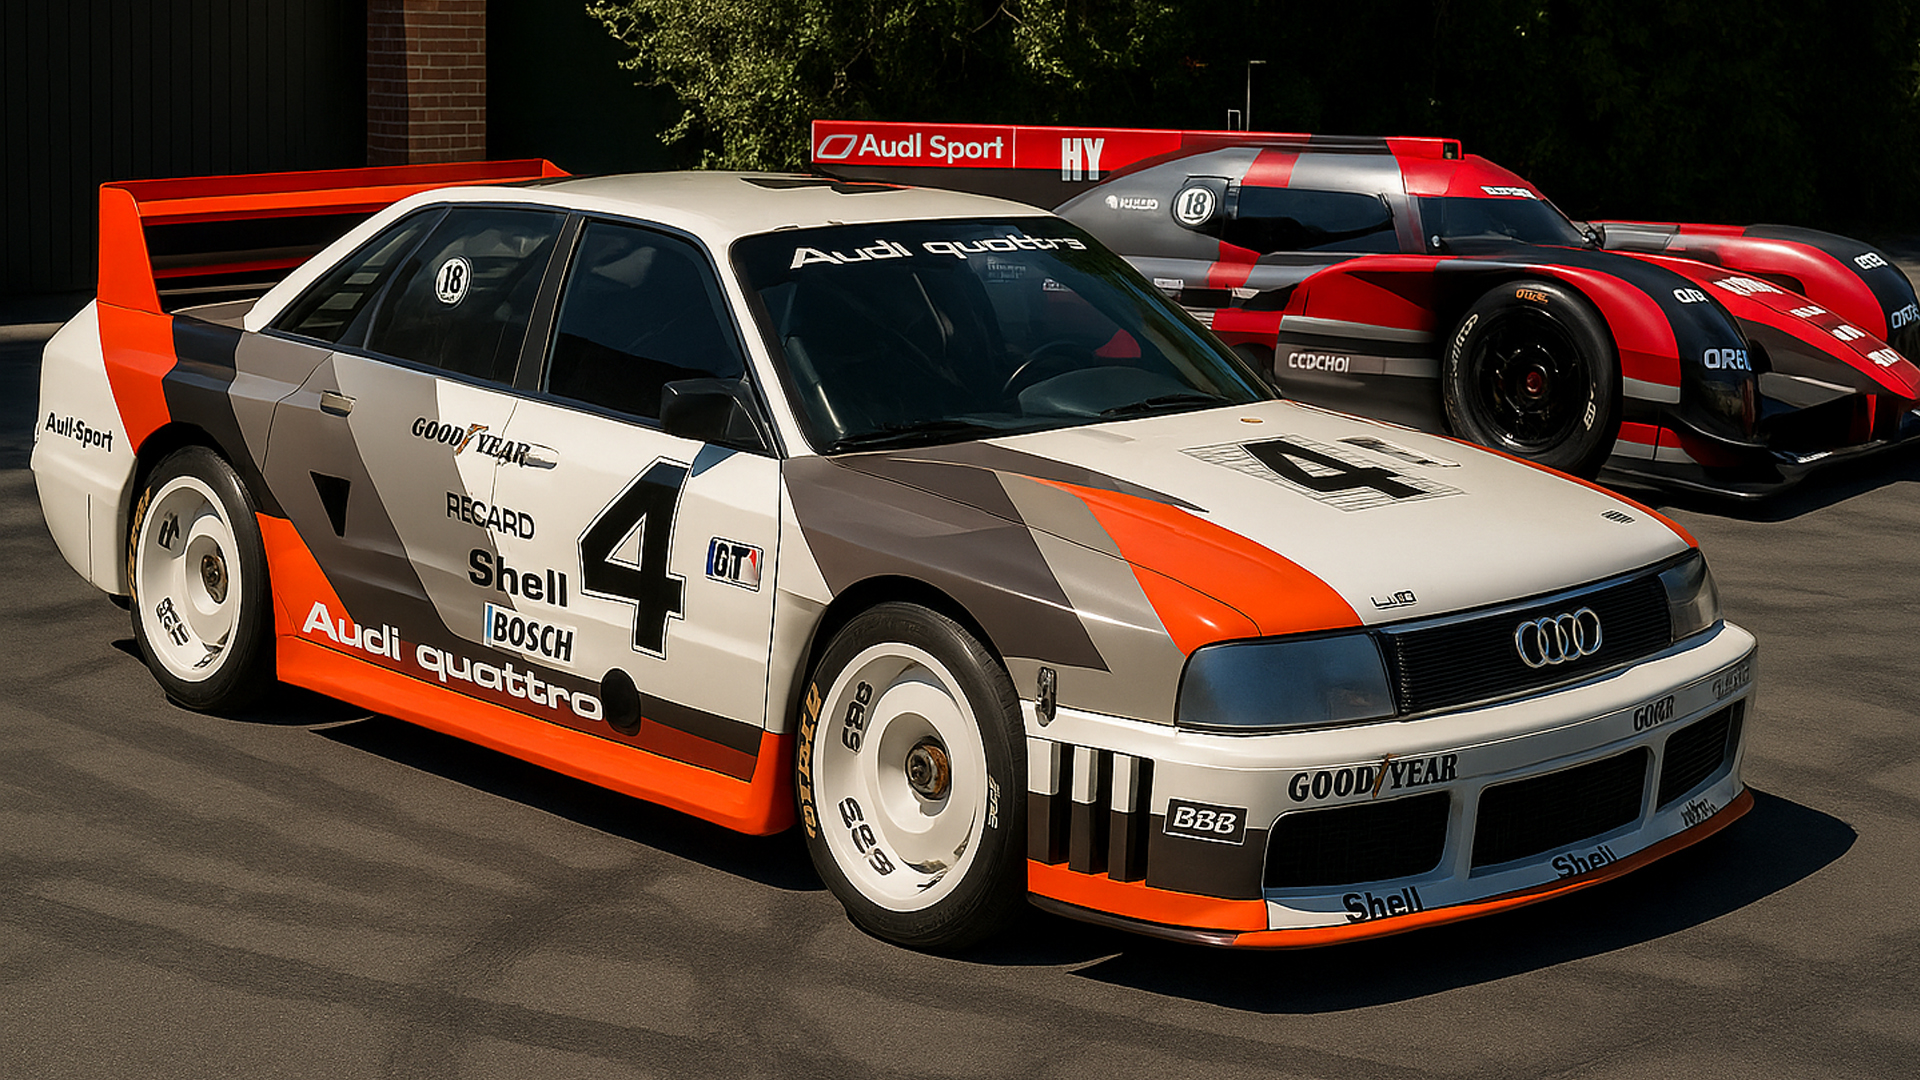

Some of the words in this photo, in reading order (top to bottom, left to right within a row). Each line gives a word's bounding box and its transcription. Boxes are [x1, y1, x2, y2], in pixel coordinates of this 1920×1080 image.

[929, 134, 1004, 164] Sport
[1061, 137, 1105, 182] HY
[1184, 192, 1208, 216] 18
[441, 264, 464, 294] 18
[1239, 438, 1430, 499] 4
[468, 548, 569, 608] Shell
[578, 457, 686, 658] 4
[493, 610, 574, 663] BOSCH
[302, 601, 402, 661] Audi
[415, 643, 604, 722] quattro
[1551, 844, 1618, 879] Shell
[1341, 885, 1424, 923] Shell
